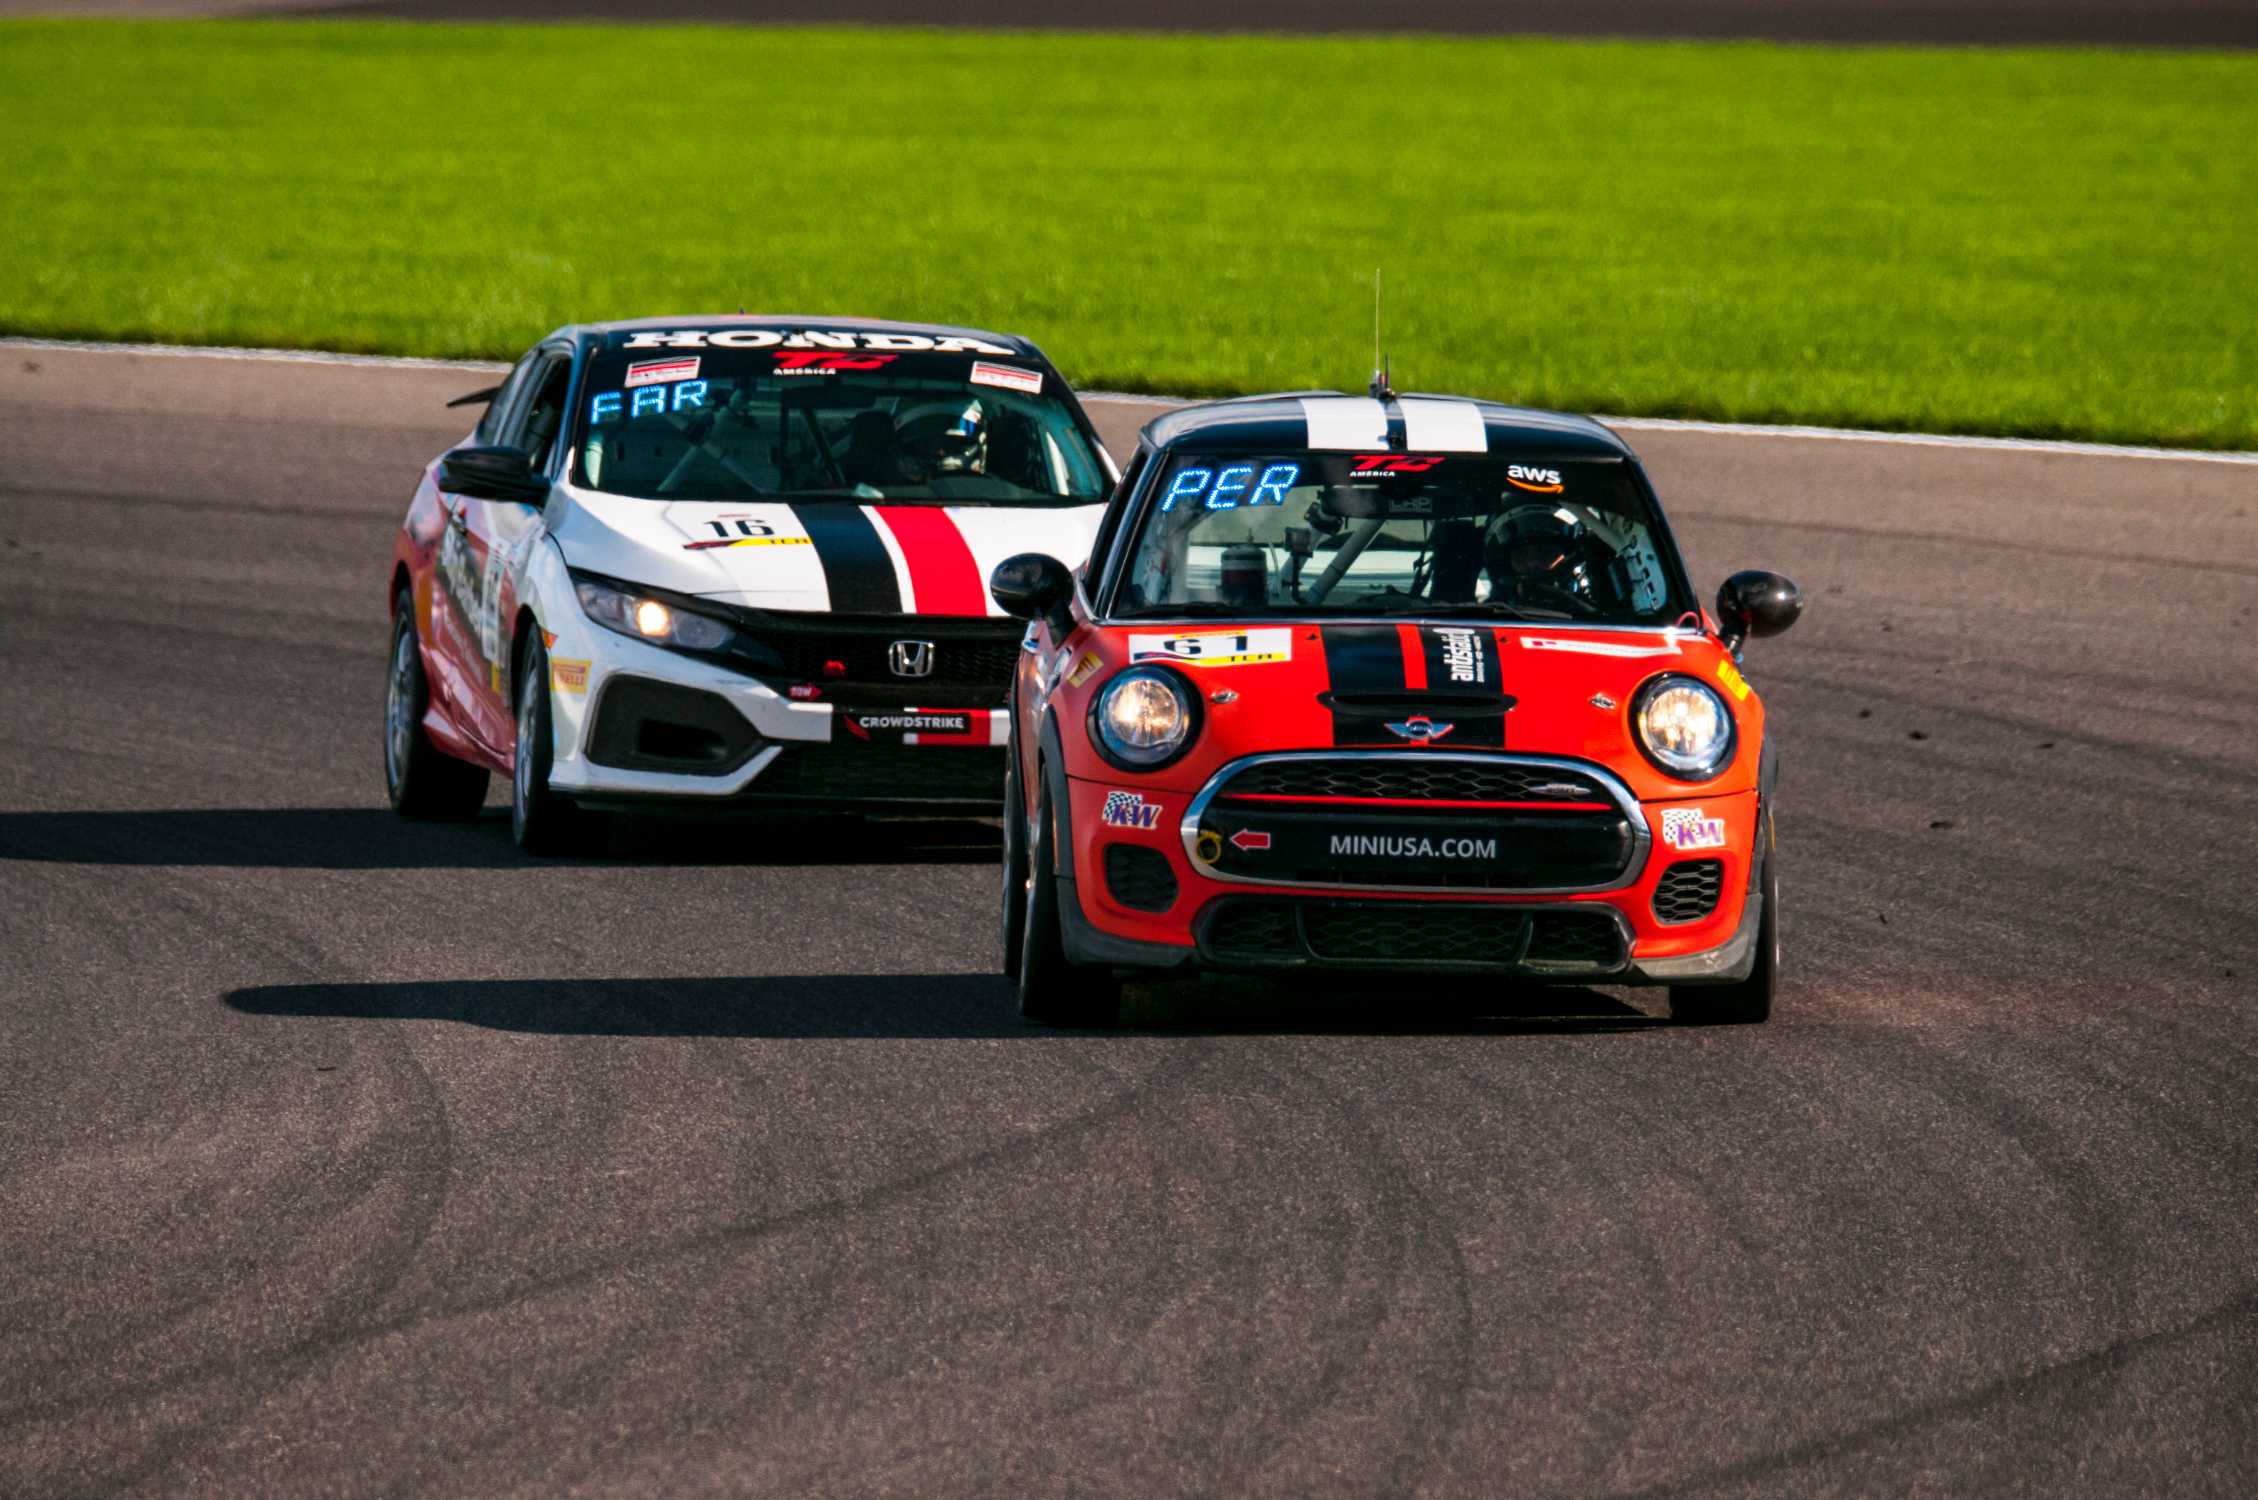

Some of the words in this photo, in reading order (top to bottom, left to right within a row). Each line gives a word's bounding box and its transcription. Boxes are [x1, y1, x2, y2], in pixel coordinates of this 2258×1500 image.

[623, 330, 1016, 355] HONDA
[773, 367, 837, 376] AMERICA
[590, 379, 708, 425] FAR
[1507, 464, 1562, 485] aws
[1161, 465, 1299, 512] PER
[703, 519, 775, 538] 16
[859, 716, 965, 729] CROWDSTRIKE
[1330, 835, 1497, 859] MINIUSA.COM
